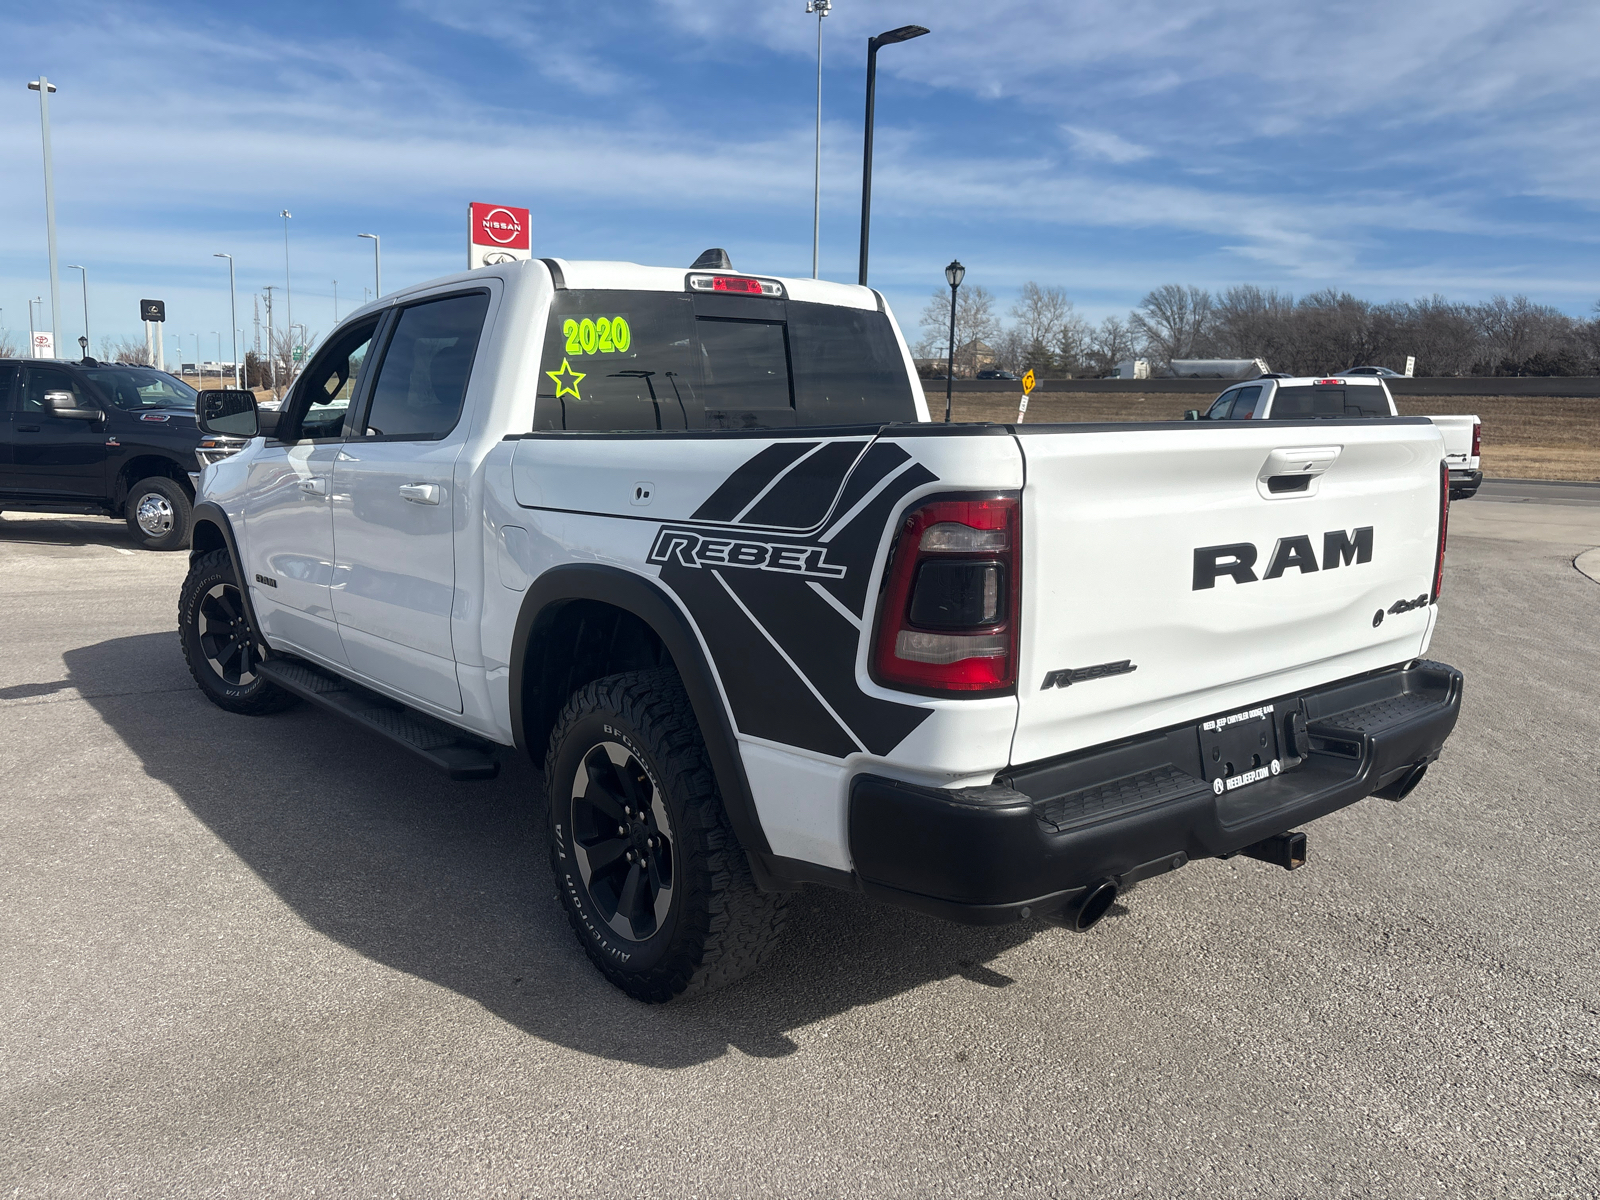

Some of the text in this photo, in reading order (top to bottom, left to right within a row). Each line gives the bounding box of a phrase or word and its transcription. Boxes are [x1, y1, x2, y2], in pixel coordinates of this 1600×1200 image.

[482, 220, 521, 231] NISSAN
[563, 316, 631, 355] 2020
[650, 529, 847, 579] REBEL
[1192, 526, 1374, 591] RAM
[1040, 659, 1138, 691] REBEL
[1203, 704, 1274, 731] REED JEEP CHRYSLER DODGE RAM
[603, 724, 674, 844] BFGoodr
[1226, 766, 1269, 790] REEDJEEP.COM
